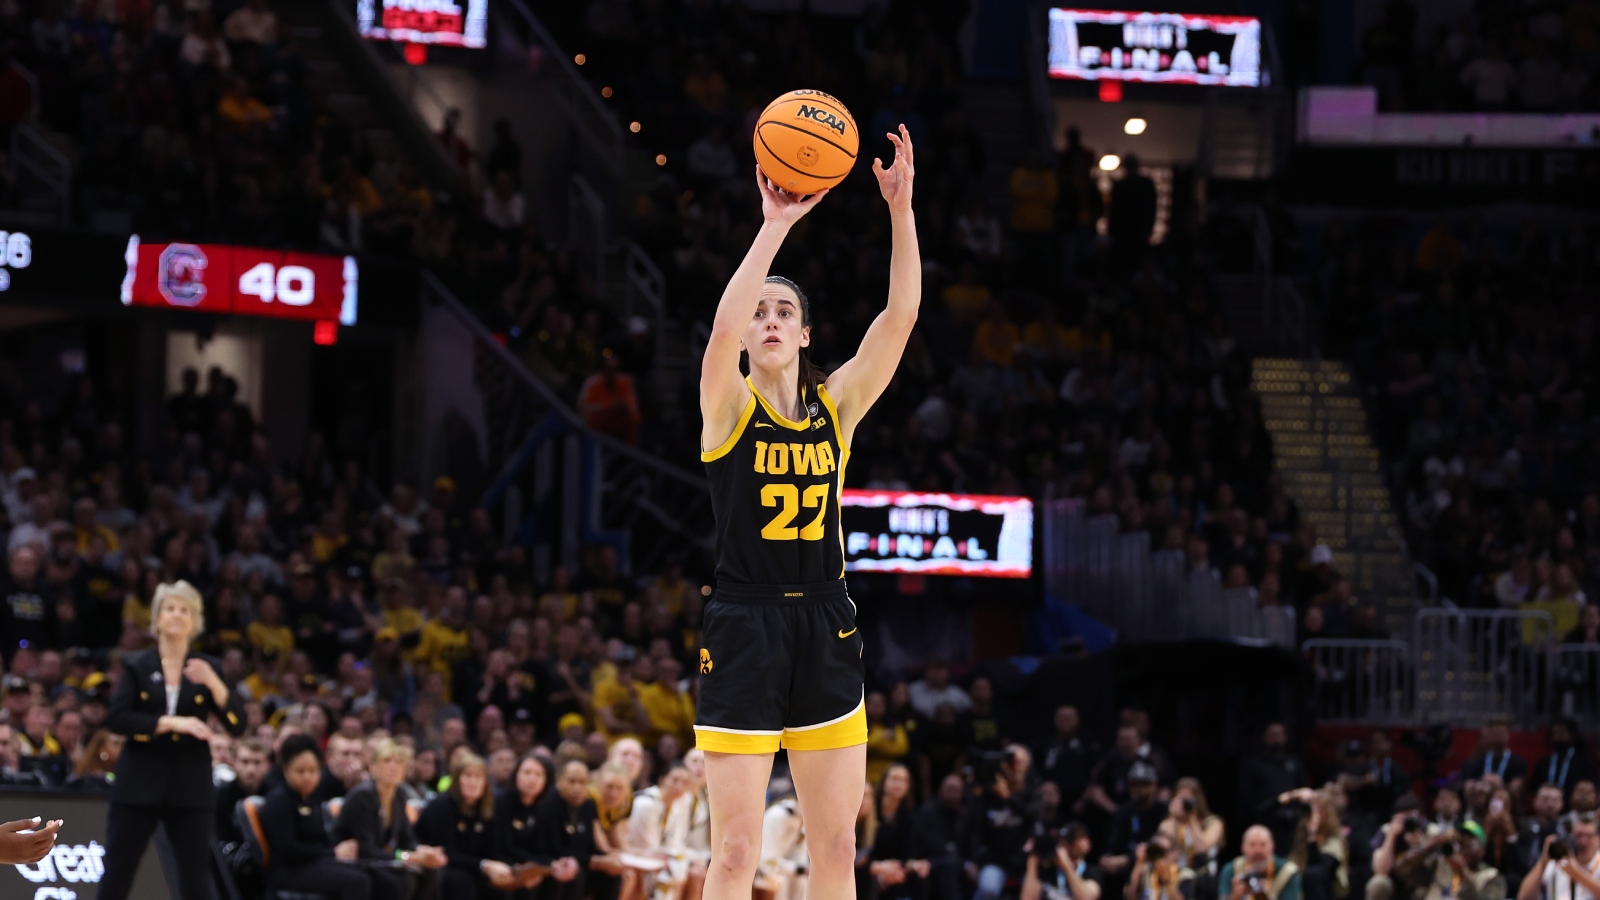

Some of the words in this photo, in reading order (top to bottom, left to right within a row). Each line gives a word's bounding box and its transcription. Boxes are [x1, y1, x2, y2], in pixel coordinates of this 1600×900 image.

[796, 104, 846, 136] NCAA
[238, 262, 315, 306] 40
[753, 440, 836, 476] IOWA
[760, 482, 830, 541] 22
